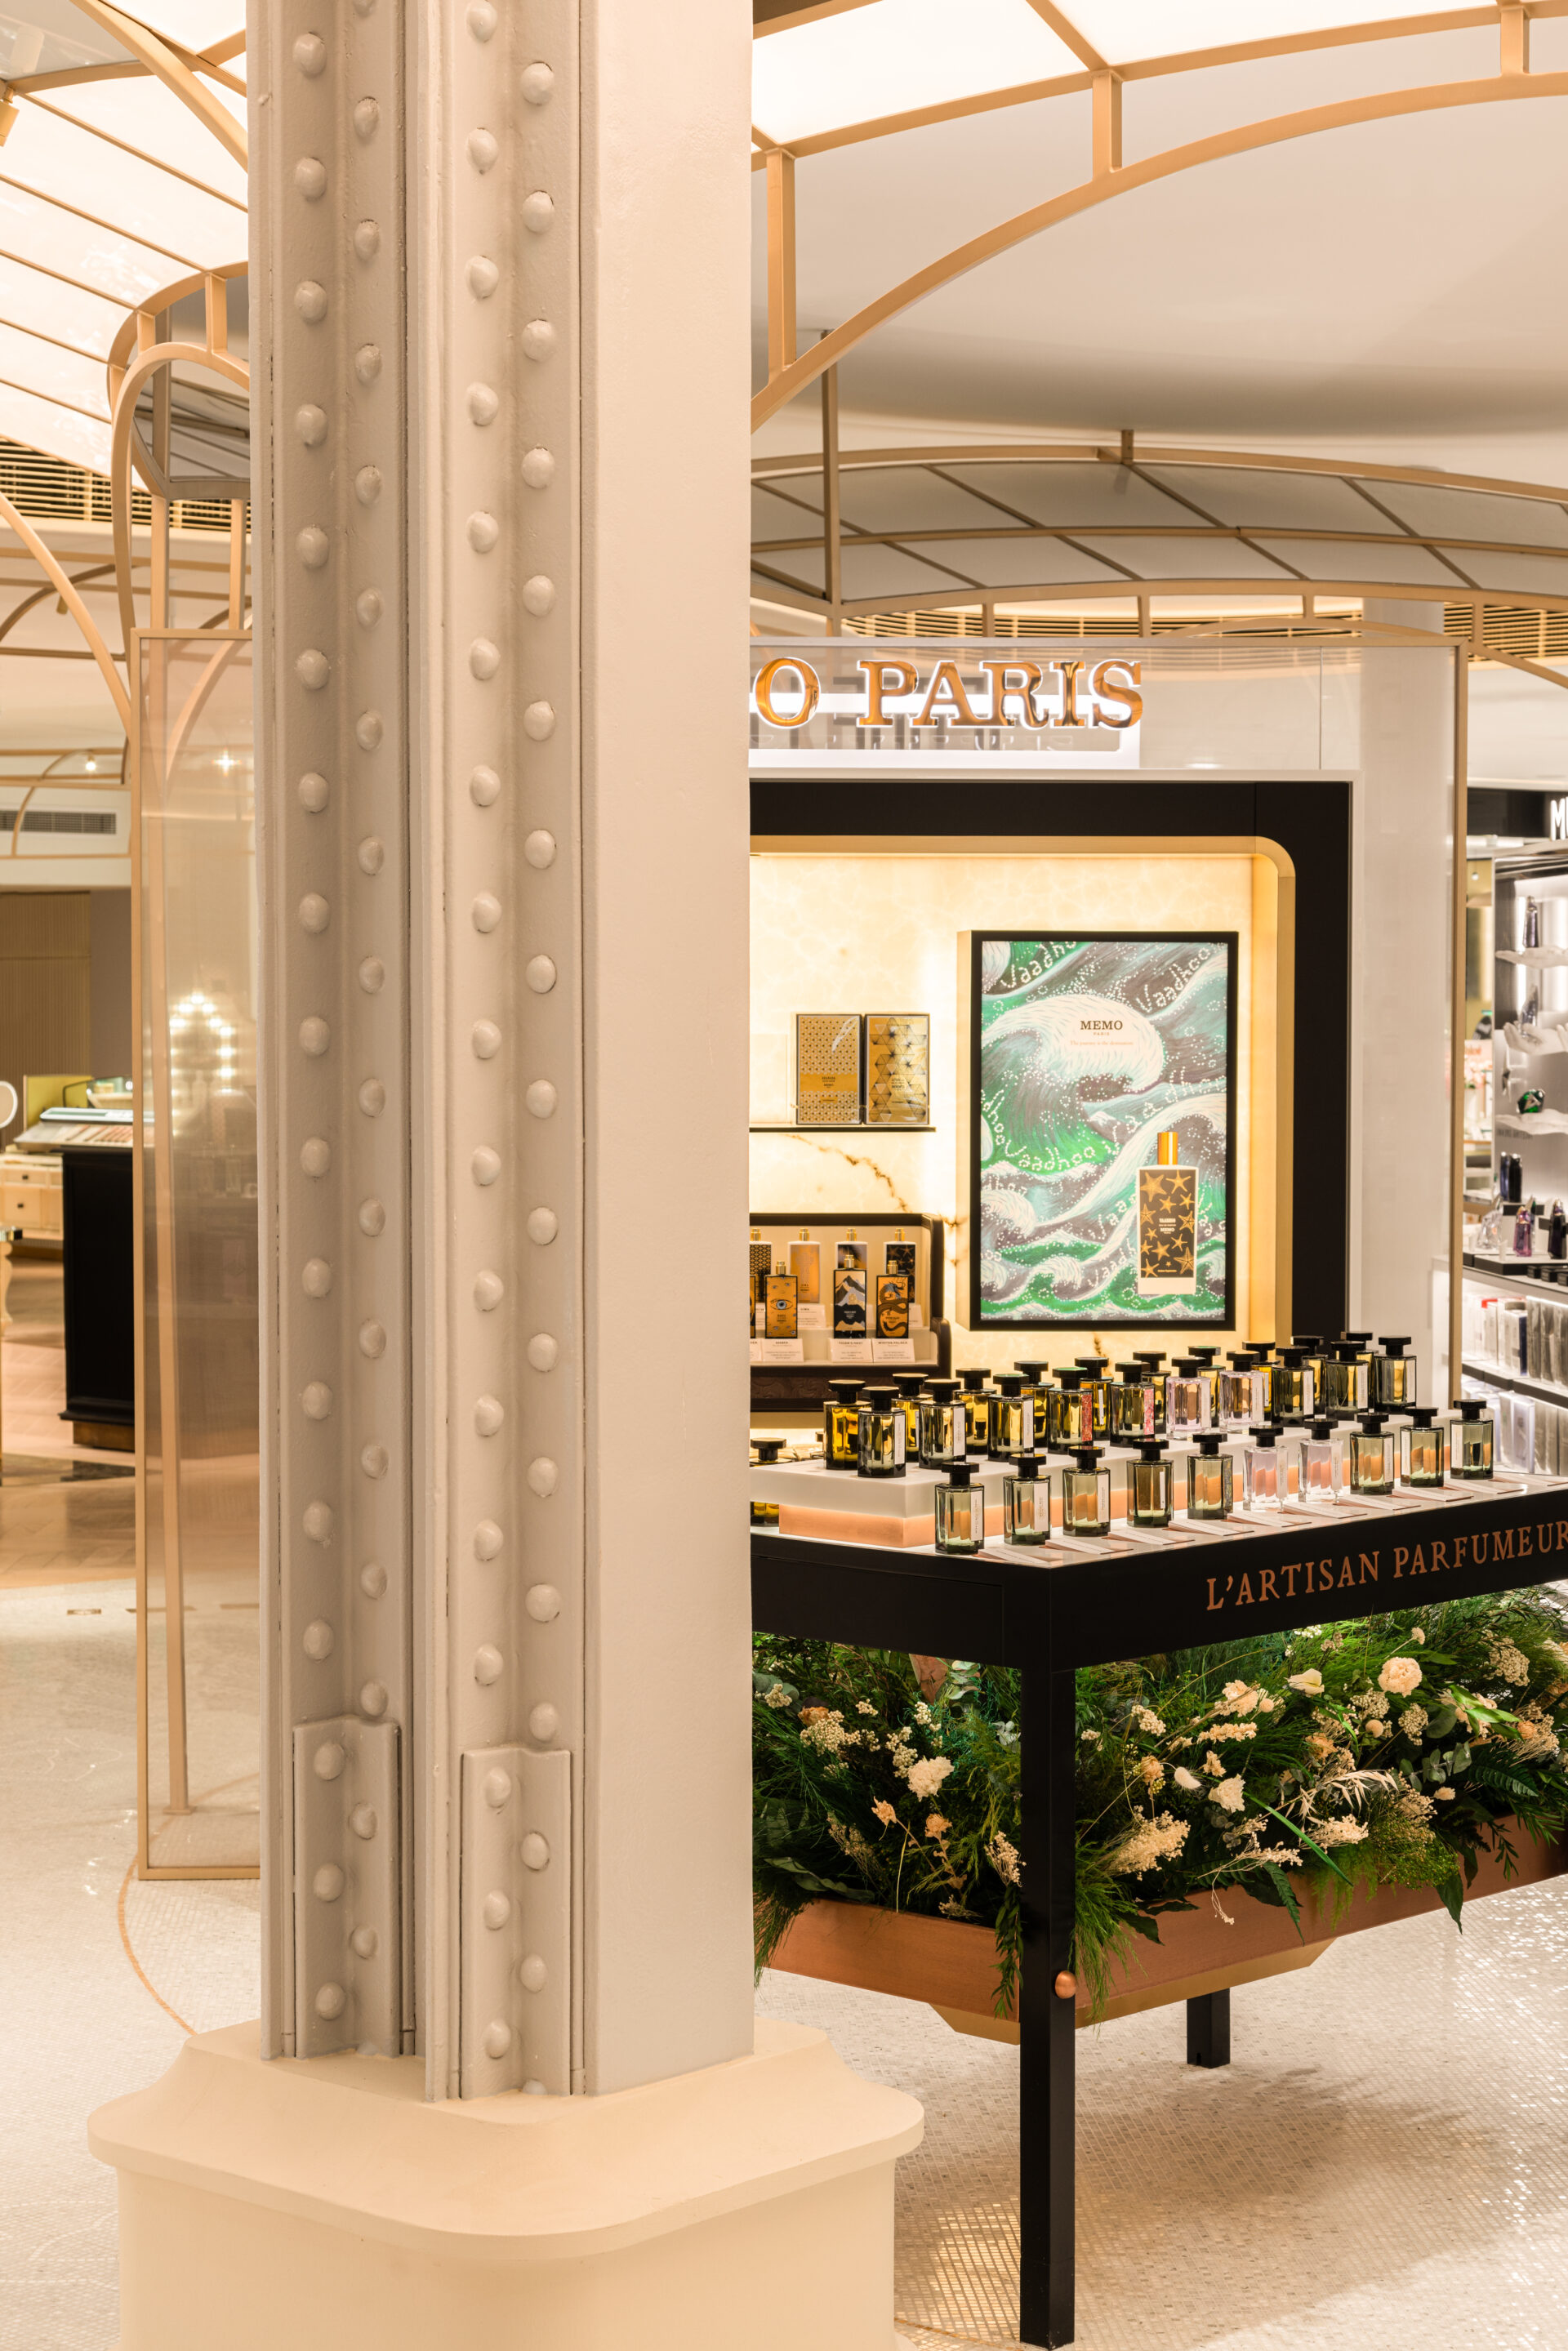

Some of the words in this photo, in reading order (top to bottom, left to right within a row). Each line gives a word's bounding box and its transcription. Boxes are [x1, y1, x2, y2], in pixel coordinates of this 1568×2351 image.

[857, 658, 1143, 729] PARIS
[1080, 1020, 1123, 1031] MEMO
[1393, 1520, 1568, 1579] PARFUMEUR
